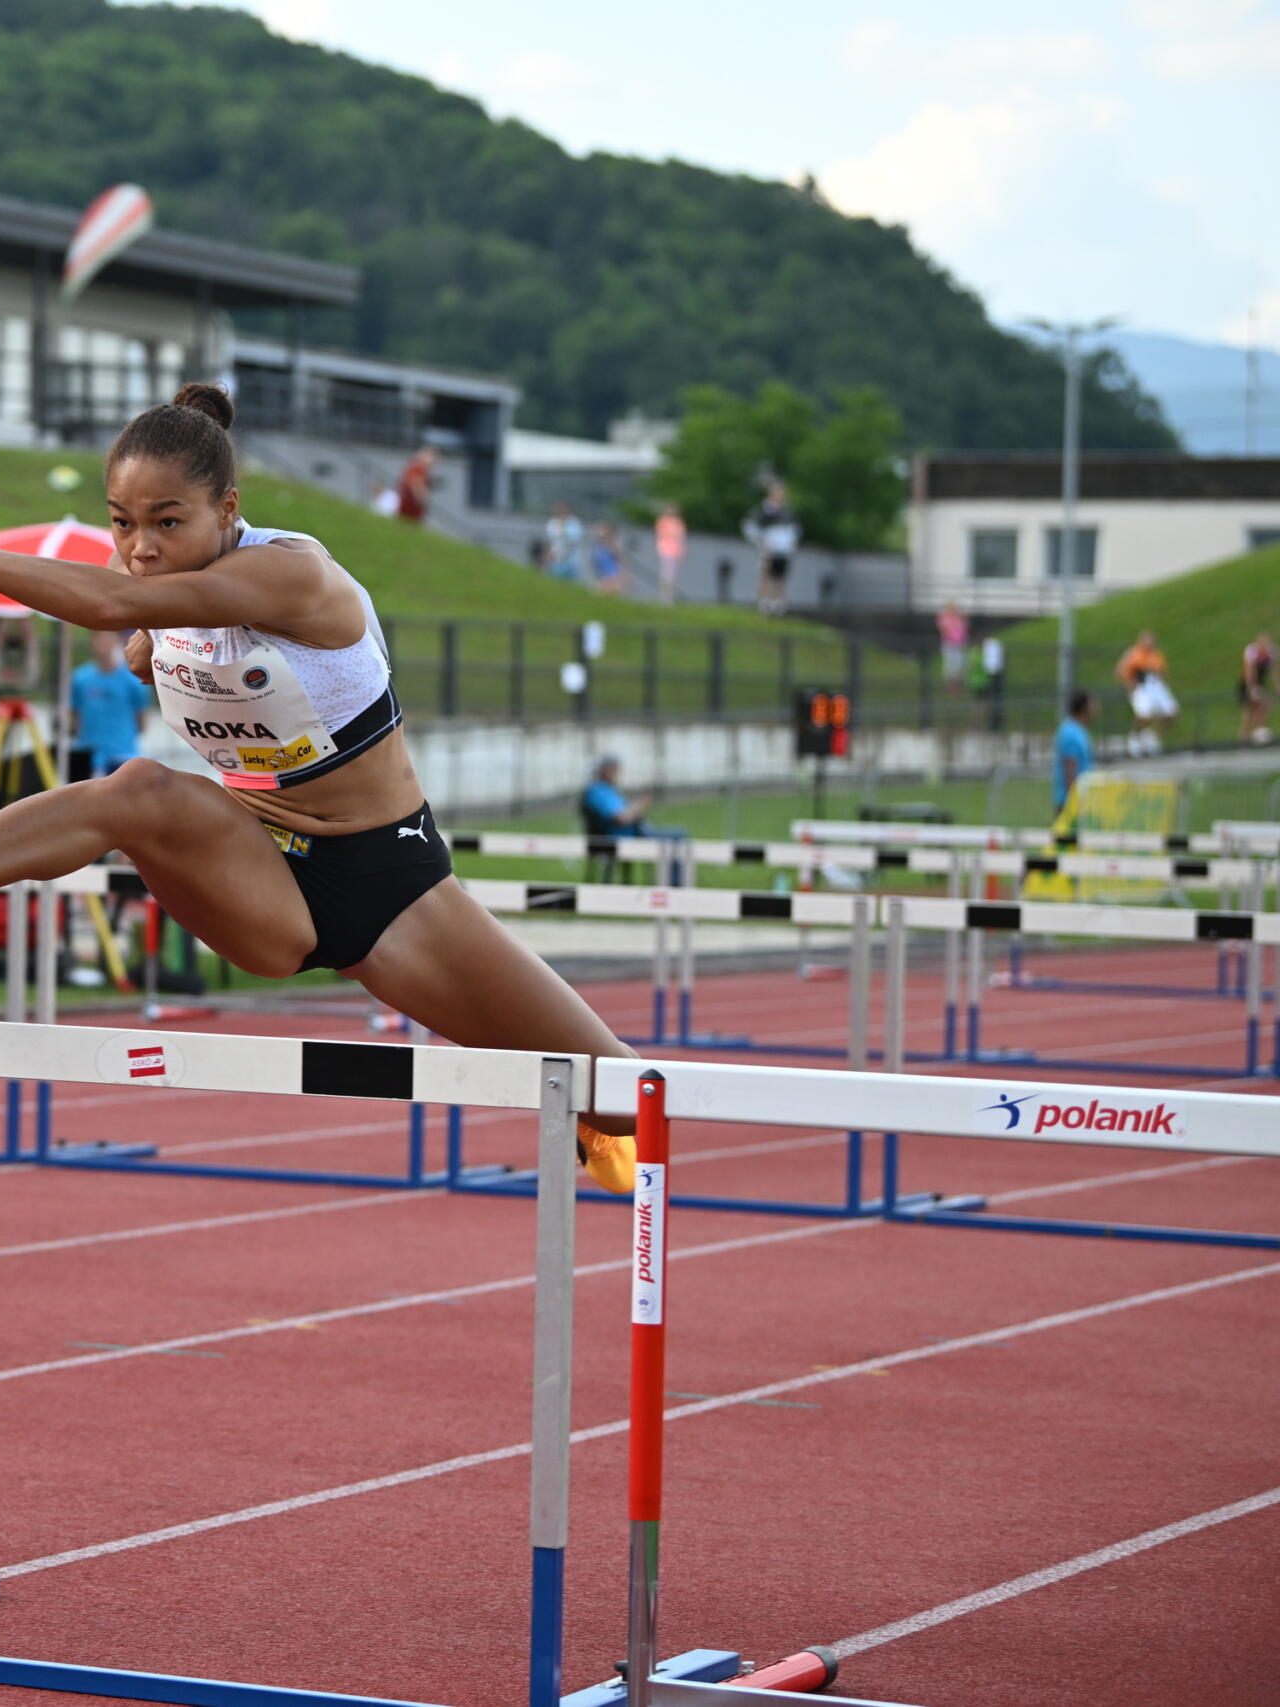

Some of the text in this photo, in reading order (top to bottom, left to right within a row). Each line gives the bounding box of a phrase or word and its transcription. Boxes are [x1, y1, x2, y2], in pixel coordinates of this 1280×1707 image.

[199, 685, 238, 696] MEMORIAL
[184, 717, 279, 741] ROKA
[243, 745, 312, 766] Lucky Car
[1034, 1099, 1178, 1134] polanik
[636, 1202, 656, 1284] polanik
